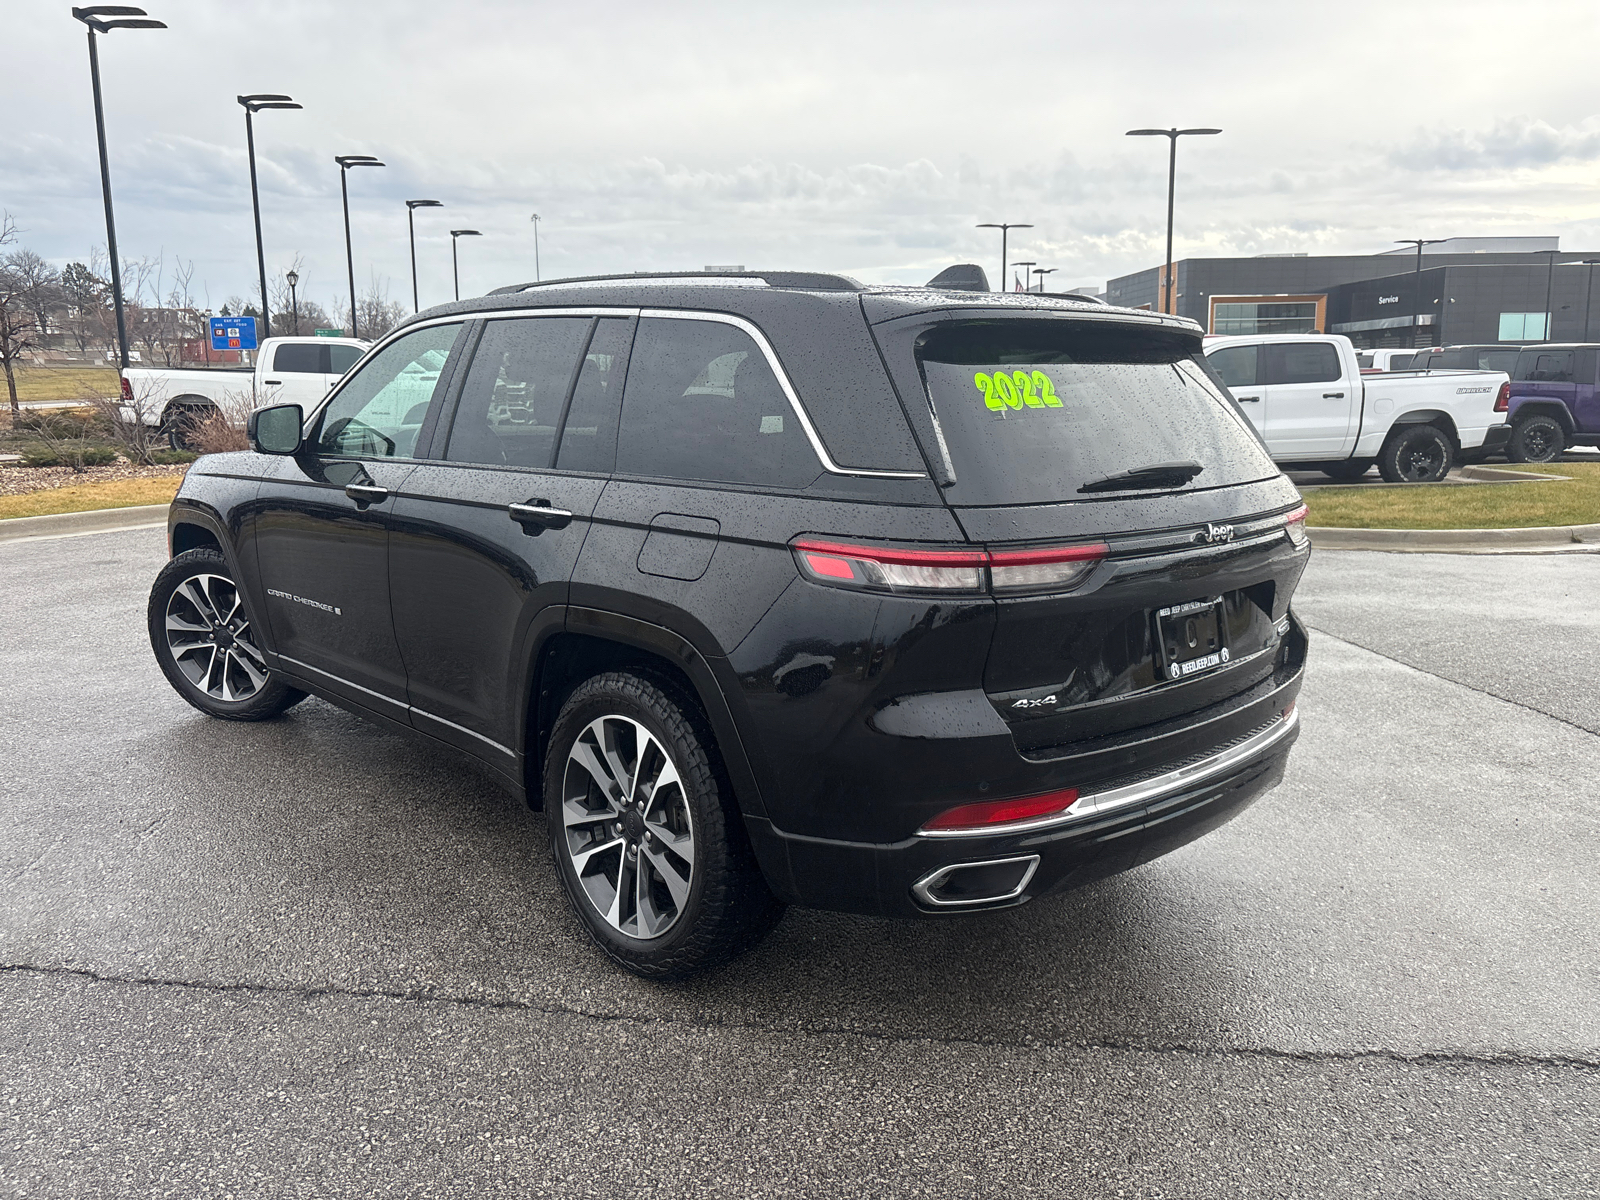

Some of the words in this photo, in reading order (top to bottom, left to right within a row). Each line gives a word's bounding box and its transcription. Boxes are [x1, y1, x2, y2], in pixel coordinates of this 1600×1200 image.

[1378, 295, 1399, 305] Service
[974, 370, 1064, 411] 2022
[1205, 523, 1234, 542] Jeep
[267, 588, 292, 600] GRAND
[293, 595, 334, 613] CHEROKEE
[1159, 607, 1171, 617] REED
[1171, 605, 1181, 614] JEEP
[1181, 601, 1201, 612] CHRYSLER
[1181, 653, 1220, 675] REEDJEEP.COM
[1011, 694, 1057, 708] 4x4
